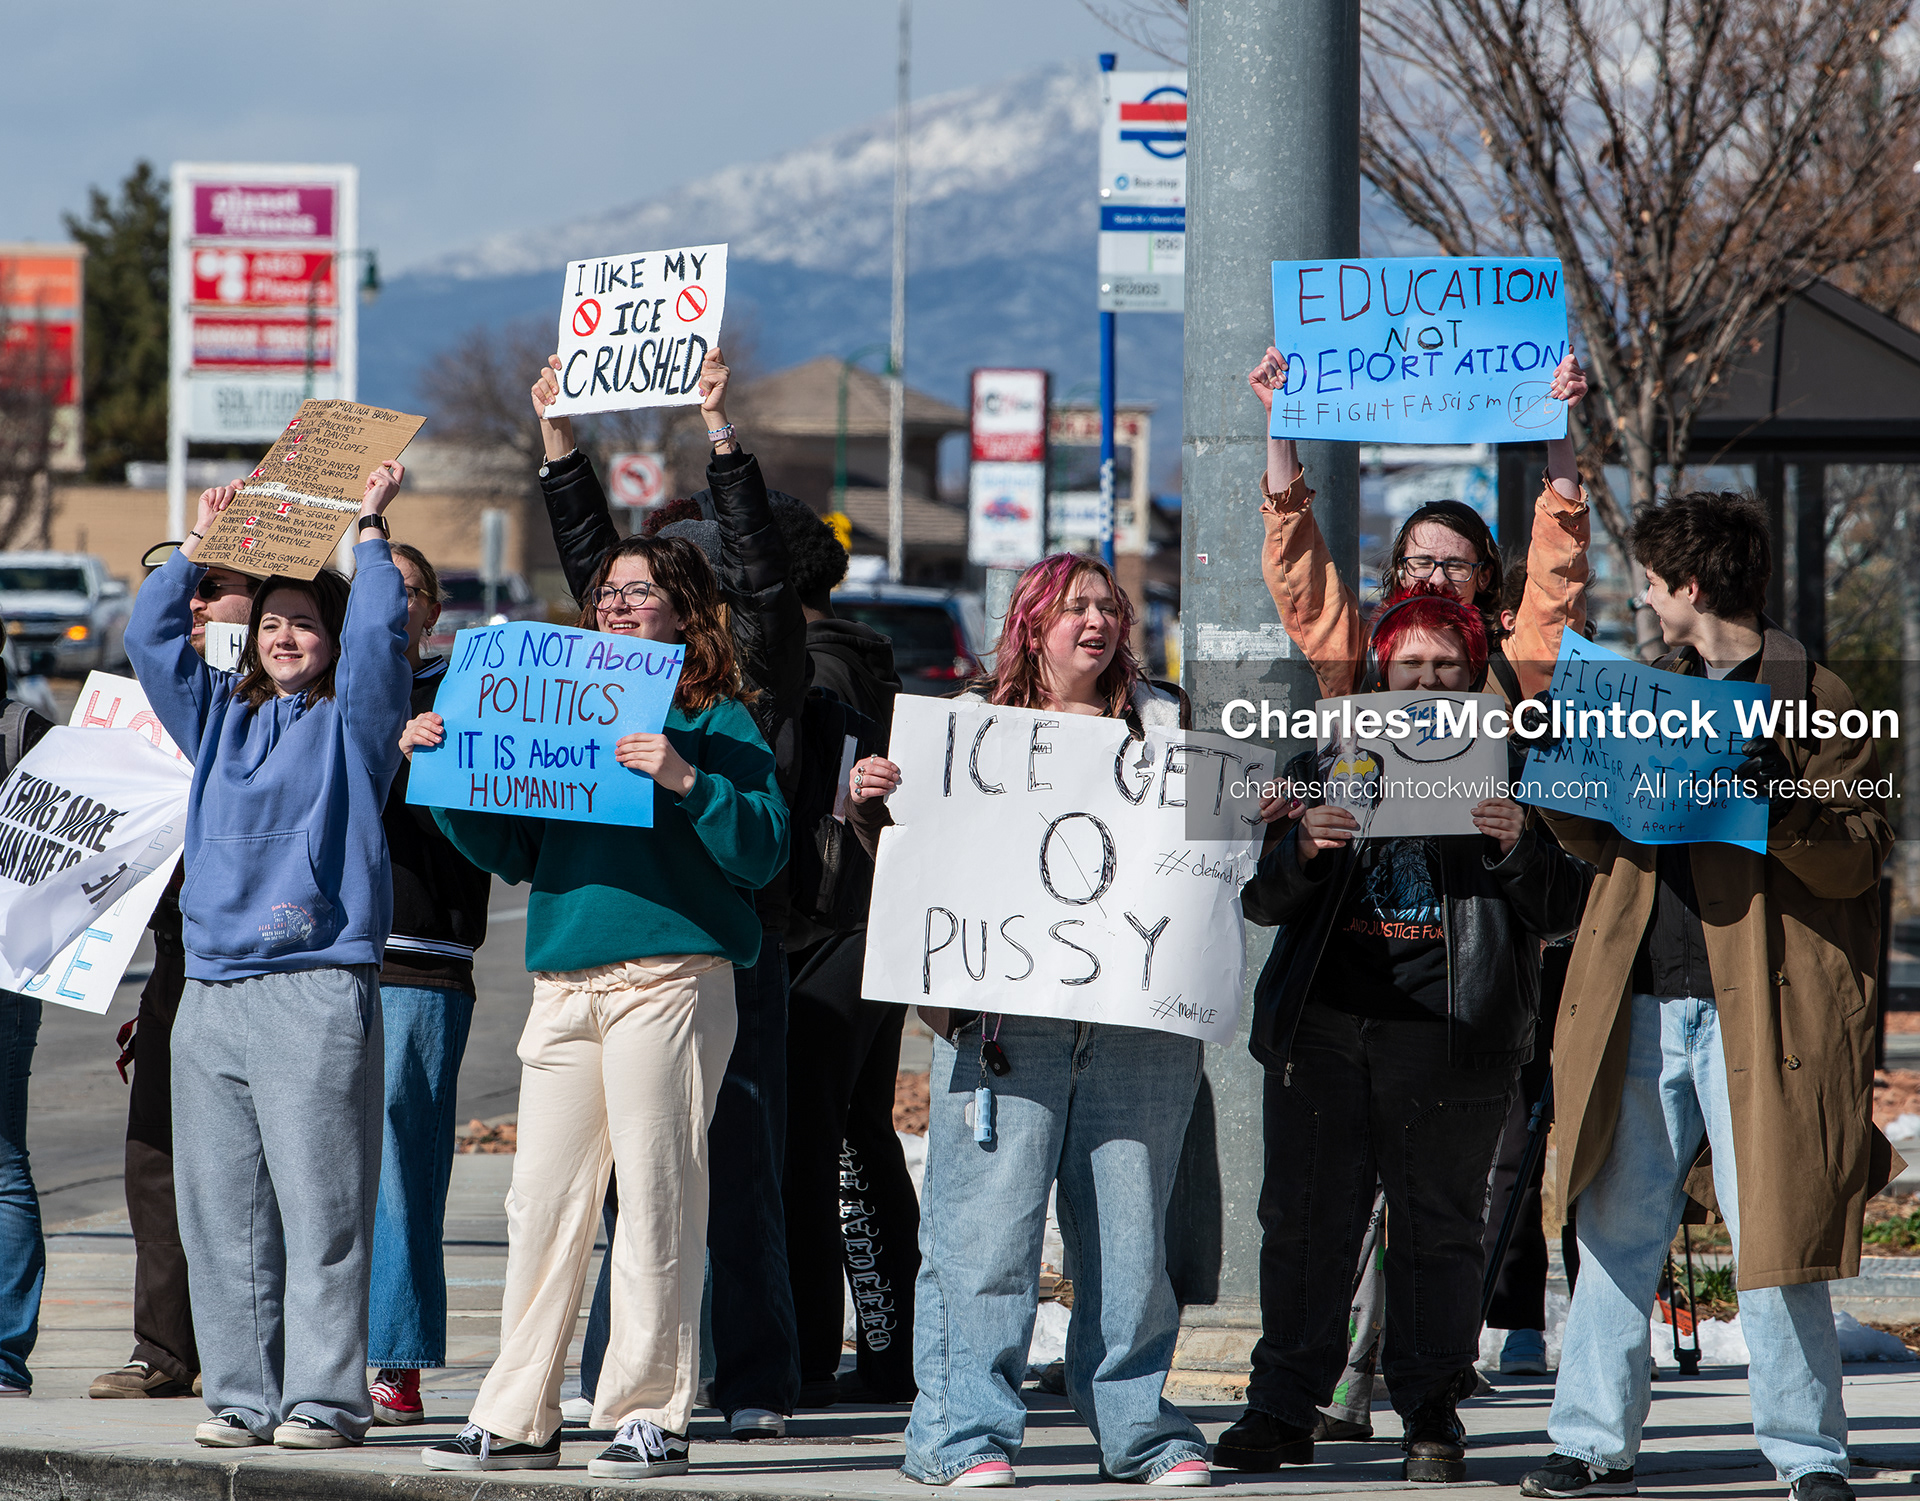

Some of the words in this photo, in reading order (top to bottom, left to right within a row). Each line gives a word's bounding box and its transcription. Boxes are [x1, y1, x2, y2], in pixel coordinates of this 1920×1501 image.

[575, 264, 586, 296] I
[664, 251, 707, 282] MY
[1299, 265, 1557, 325] EDUCATION
[609, 299, 666, 335] ICE
[1385, 320, 1462, 353] NOT
[563, 332, 708, 398] CRUSHED
[331, 411, 362, 424] ALANIS
[372, 410, 398, 422] BRAVO
[312, 436, 339, 450] MATEO
[338, 442, 368, 454] LOPEZ
[323, 430, 350, 441] DAVIS
[300, 444, 329, 456] GOOD
[284, 468, 320, 482] PORTER
[299, 480, 345, 495] MOSQUEDA
[321, 469, 358, 480] BARBOZA
[208, 535, 231, 543] ALEX
[240, 527, 264, 538] DAVID
[265, 530, 312, 548] MARTINEZ
[293, 519, 336, 532] BALTAZAR
[303, 530, 333, 541] VALDEZ
[197, 551, 231, 560] HECTOR
[232, 554, 262, 567] LOPEZ
[262, 558, 290, 572] LOPEZ
[238, 544, 277, 561] VILLEGAS
[518, 630, 583, 668] NOT
[1561, 649, 1671, 714] FIGHT
[478, 673, 625, 726] POLITICS
[458, 731, 482, 769] IT
[494, 734, 515, 771] IS
[943, 711, 1059, 798] ICE
[1114, 733, 1264, 826] GETS
[1533, 744, 1736, 791] IMMIGRATIO
[469, 773, 598, 813] HUMANITY
[50, 794, 130, 853] MORE
[18, 833, 66, 886] HATE
[1368, 921, 1420, 939] JUSTICE
[922, 906, 1172, 994] PUSSY
